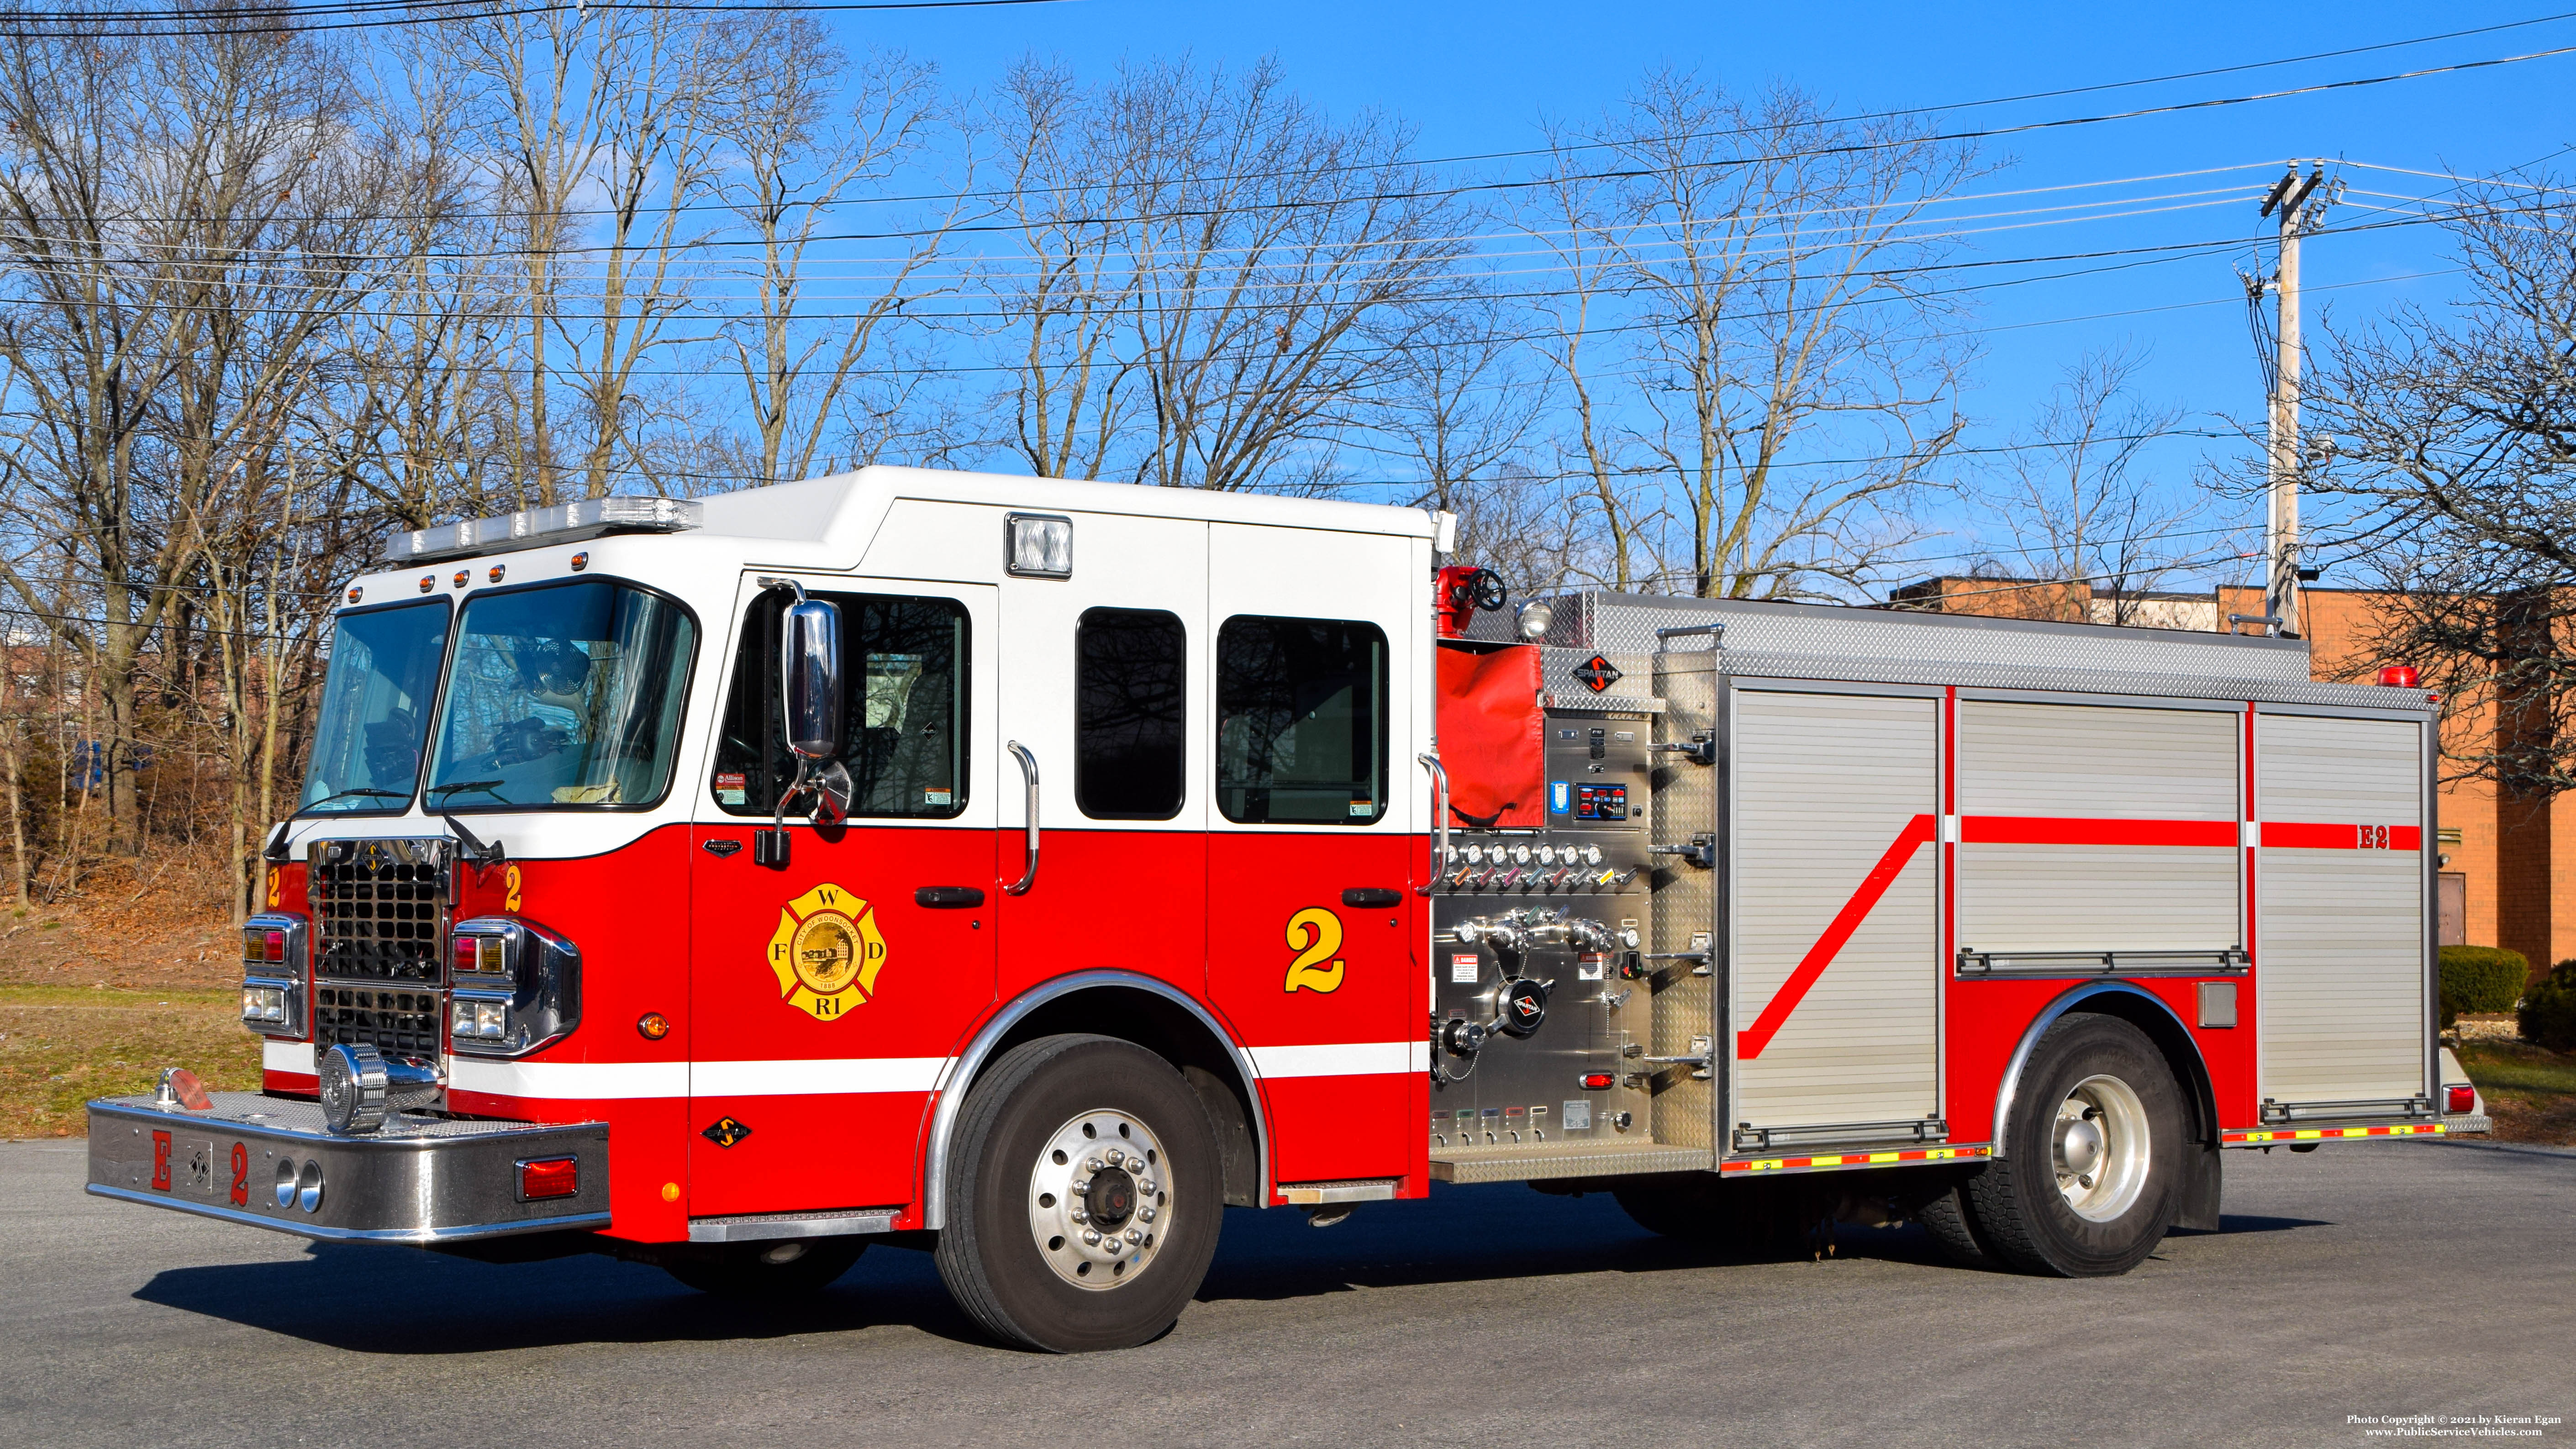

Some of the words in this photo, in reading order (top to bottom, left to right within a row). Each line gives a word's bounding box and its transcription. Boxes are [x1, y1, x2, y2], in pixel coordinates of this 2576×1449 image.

[1577, 669, 1619, 680] SPARTAN
[2359, 825, 2387, 849] E2
[268, 866, 279, 907] 2
[505, 864, 522, 913] 2
[817, 889, 839, 906] W
[797, 928, 807, 945] CITY
[807, 919, 816, 928] OF
[817, 916, 859, 944] WOONSOCKET
[774, 943, 788, 960] F
[868, 942, 884, 959] D
[1284, 905, 1346, 994] 2
[815, 997, 841, 1015] RI
[1517, 1000, 1538, 1012] SPARTAN
[706, 1128, 748, 1137] SPARTAN
[151, 1129, 172, 1192] E
[230, 1141, 248, 1207] 2
